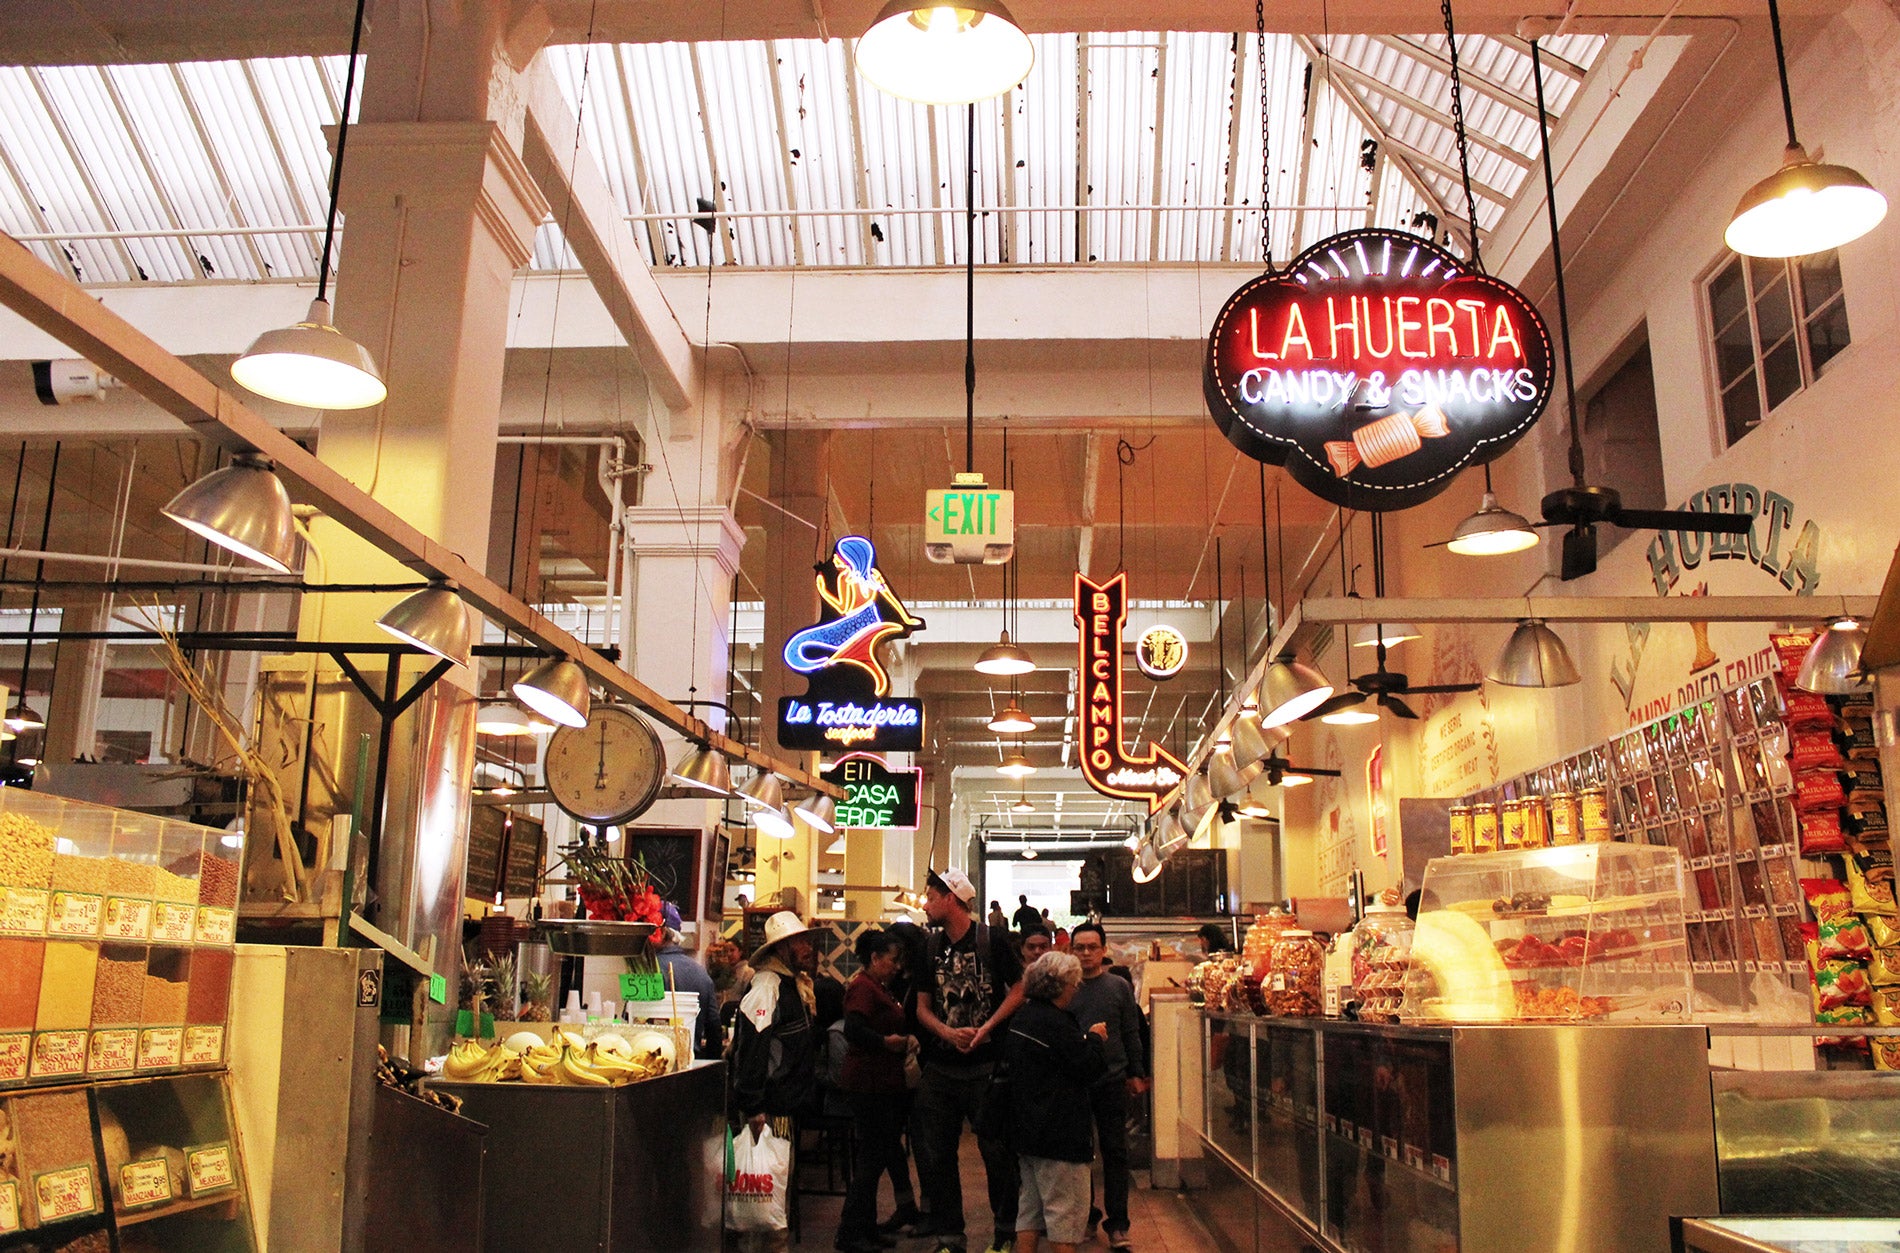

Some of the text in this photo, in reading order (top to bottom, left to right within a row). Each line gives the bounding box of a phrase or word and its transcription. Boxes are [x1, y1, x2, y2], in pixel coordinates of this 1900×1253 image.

[1250, 295, 1521, 360] LA HUERTA
[1241, 367, 1538, 405] CANDY & SNACKS
[942, 493, 1000, 535] EXIT
[1646, 483, 1821, 597] HUERTA
[1091, 593, 1112, 770] BELCAMPO
[1629, 646, 1773, 727] CANDY DRIED FRUIT
[786, 700, 812, 723] La
[825, 725, 877, 745] seafood
[844, 784, 900, 805] CASA
[834, 804, 894, 827] ERDE
[125, 1188, 163, 1202] MANZANILLA
